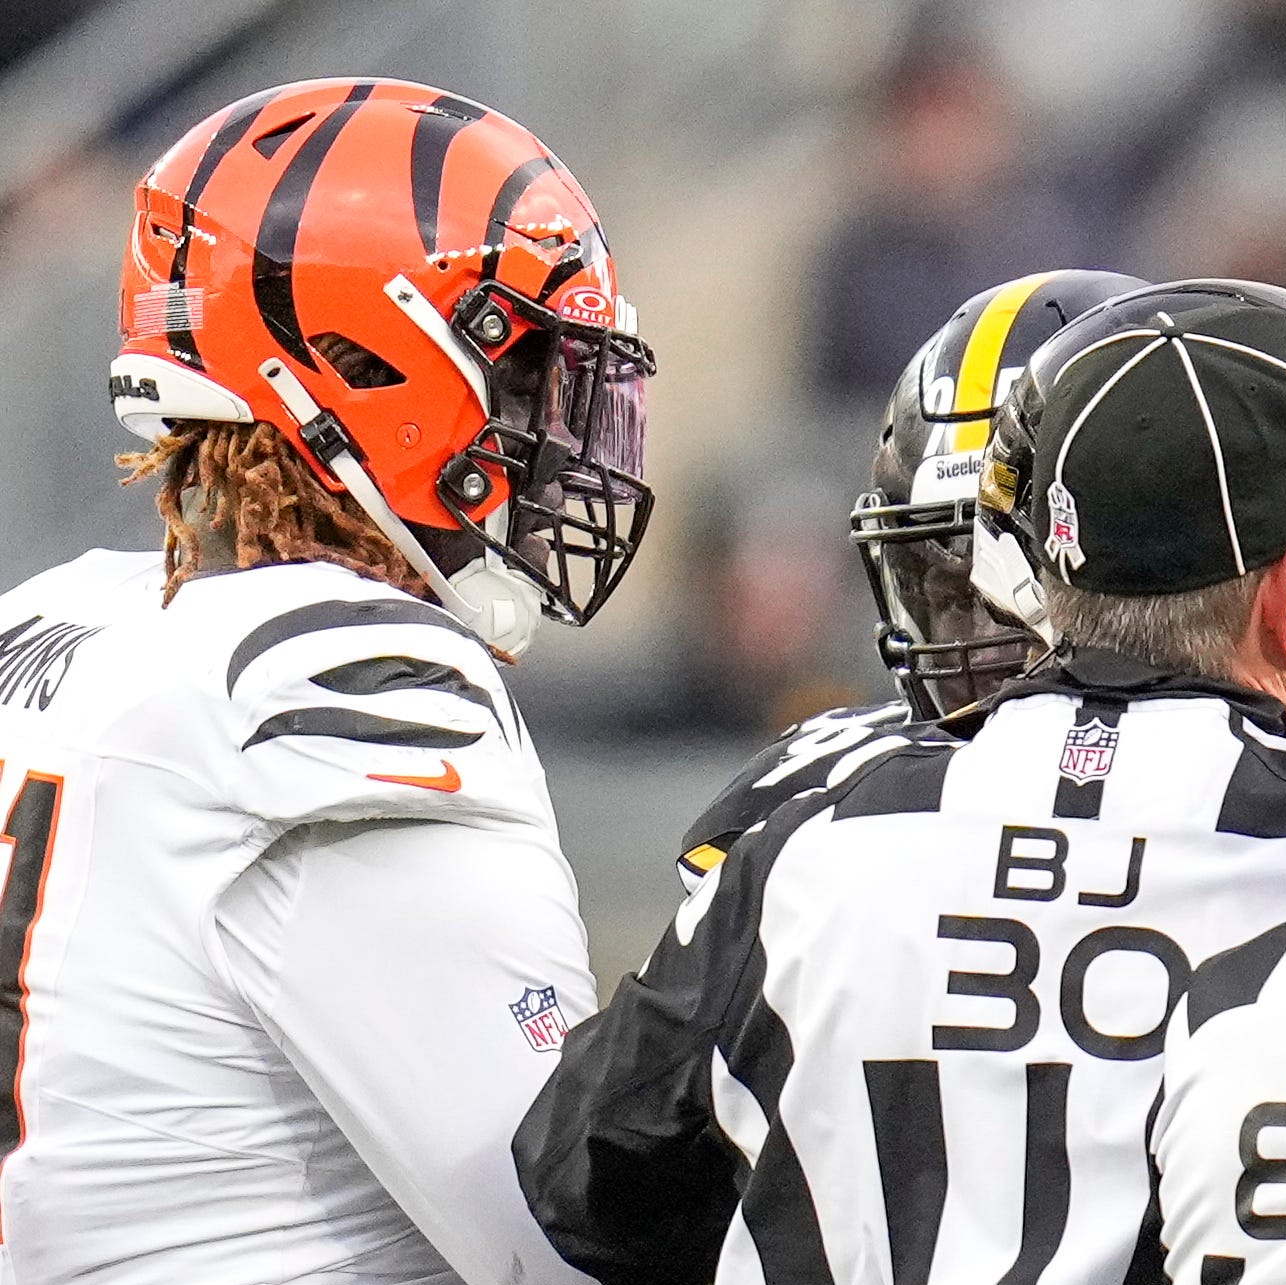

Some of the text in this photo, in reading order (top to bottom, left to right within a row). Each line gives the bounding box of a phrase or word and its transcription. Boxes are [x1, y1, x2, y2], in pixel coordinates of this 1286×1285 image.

[562, 305, 612, 326] OAKLEY
[936, 456, 985, 480] Steele
[1064, 746, 1110, 776] NFL
[992, 824, 1148, 908] BJ
[931, 913, 1195, 1062] 30
[523, 1015, 569, 1049] NFL
